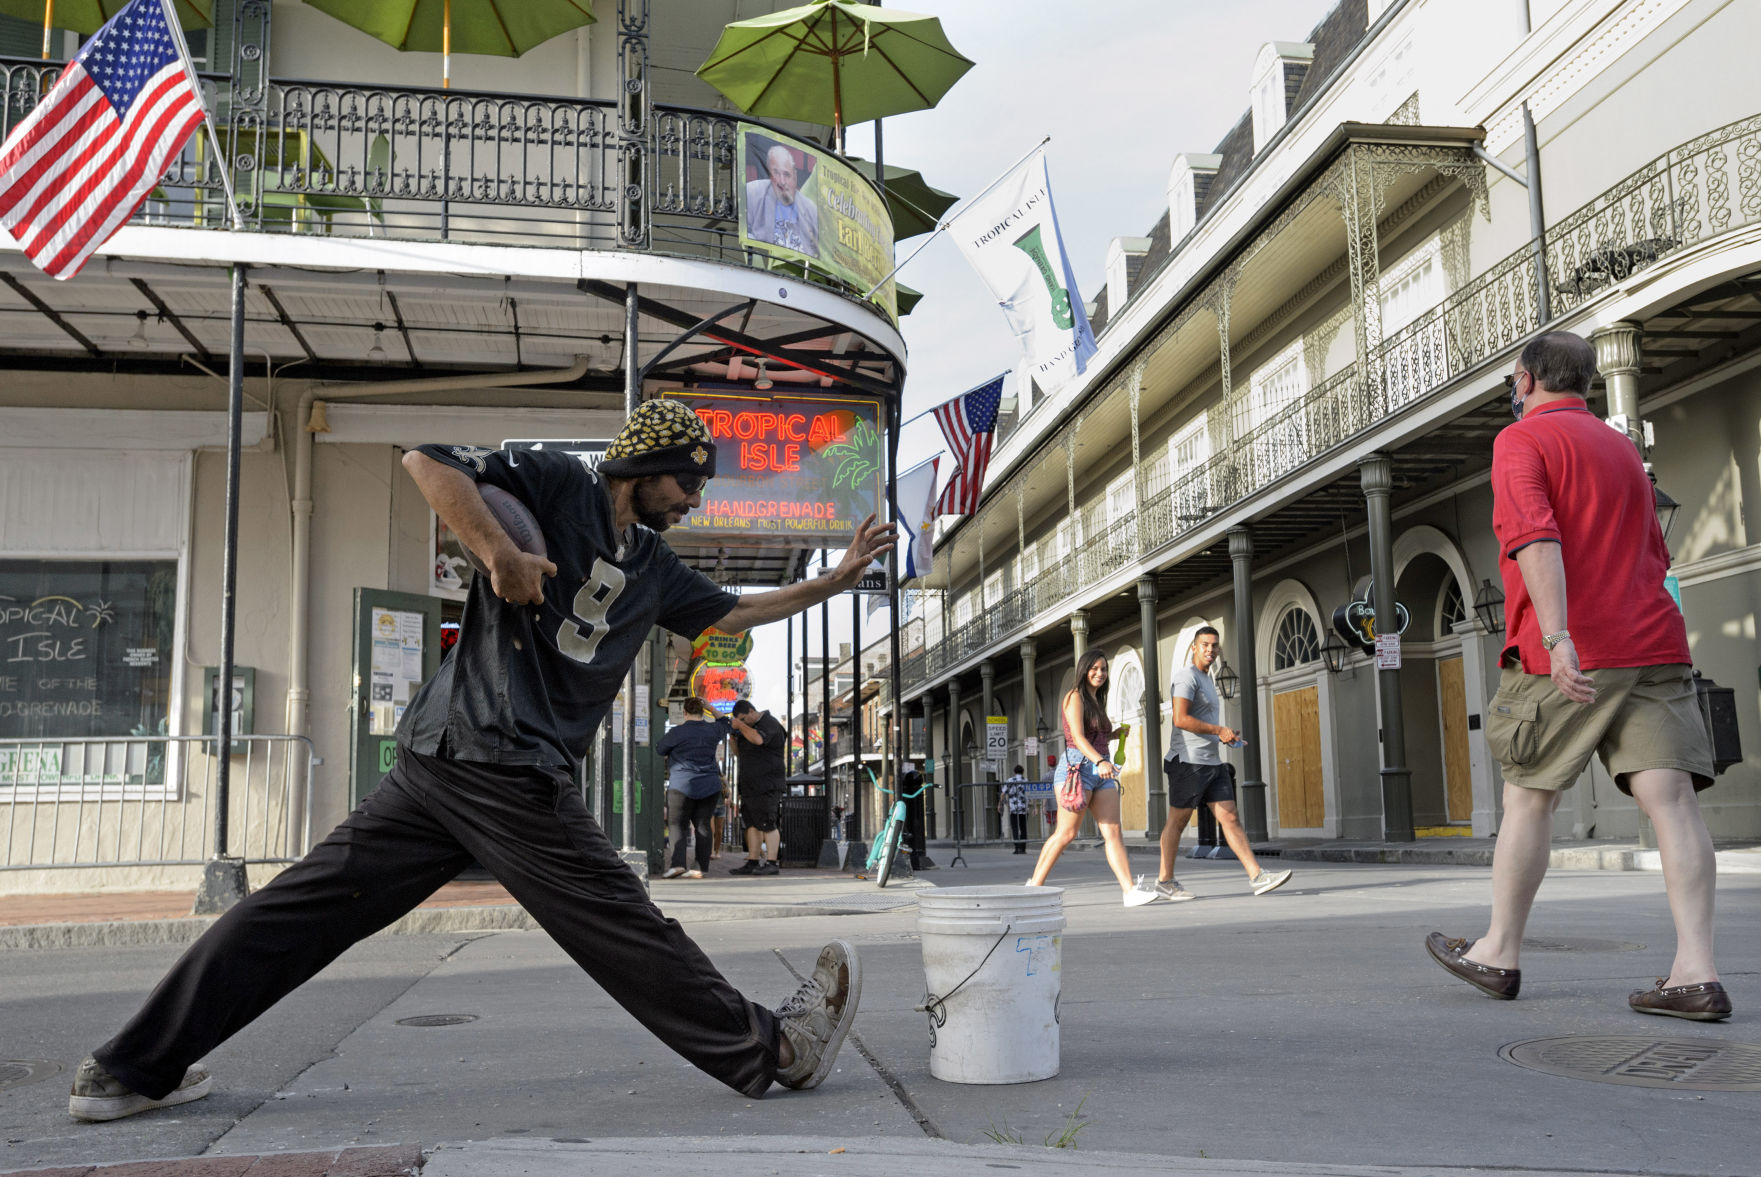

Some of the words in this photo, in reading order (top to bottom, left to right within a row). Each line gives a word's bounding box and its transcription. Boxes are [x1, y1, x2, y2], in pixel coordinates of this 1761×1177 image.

[973, 206, 1025, 249] TROPICAL
[694, 408, 847, 442] TROPICAL
[740, 442, 801, 472] ISLE
[690, 516, 711, 527] NEW
[757, 518, 781, 530] MOST
[785, 519, 827, 530] POWERFUL
[556, 557, 626, 664] 9
[7, 632, 86, 662] ISLE
[708, 635, 739, 643] DRINKS
[706, 649, 719, 658] TO
[722, 650, 736, 659] GO
[38, 678, 61, 690] OF
[66, 677, 98, 690] THE
[16, 701, 104, 717] GRENADE
[988, 737, 1006, 748] 20
[383, 746, 398, 767] OP
